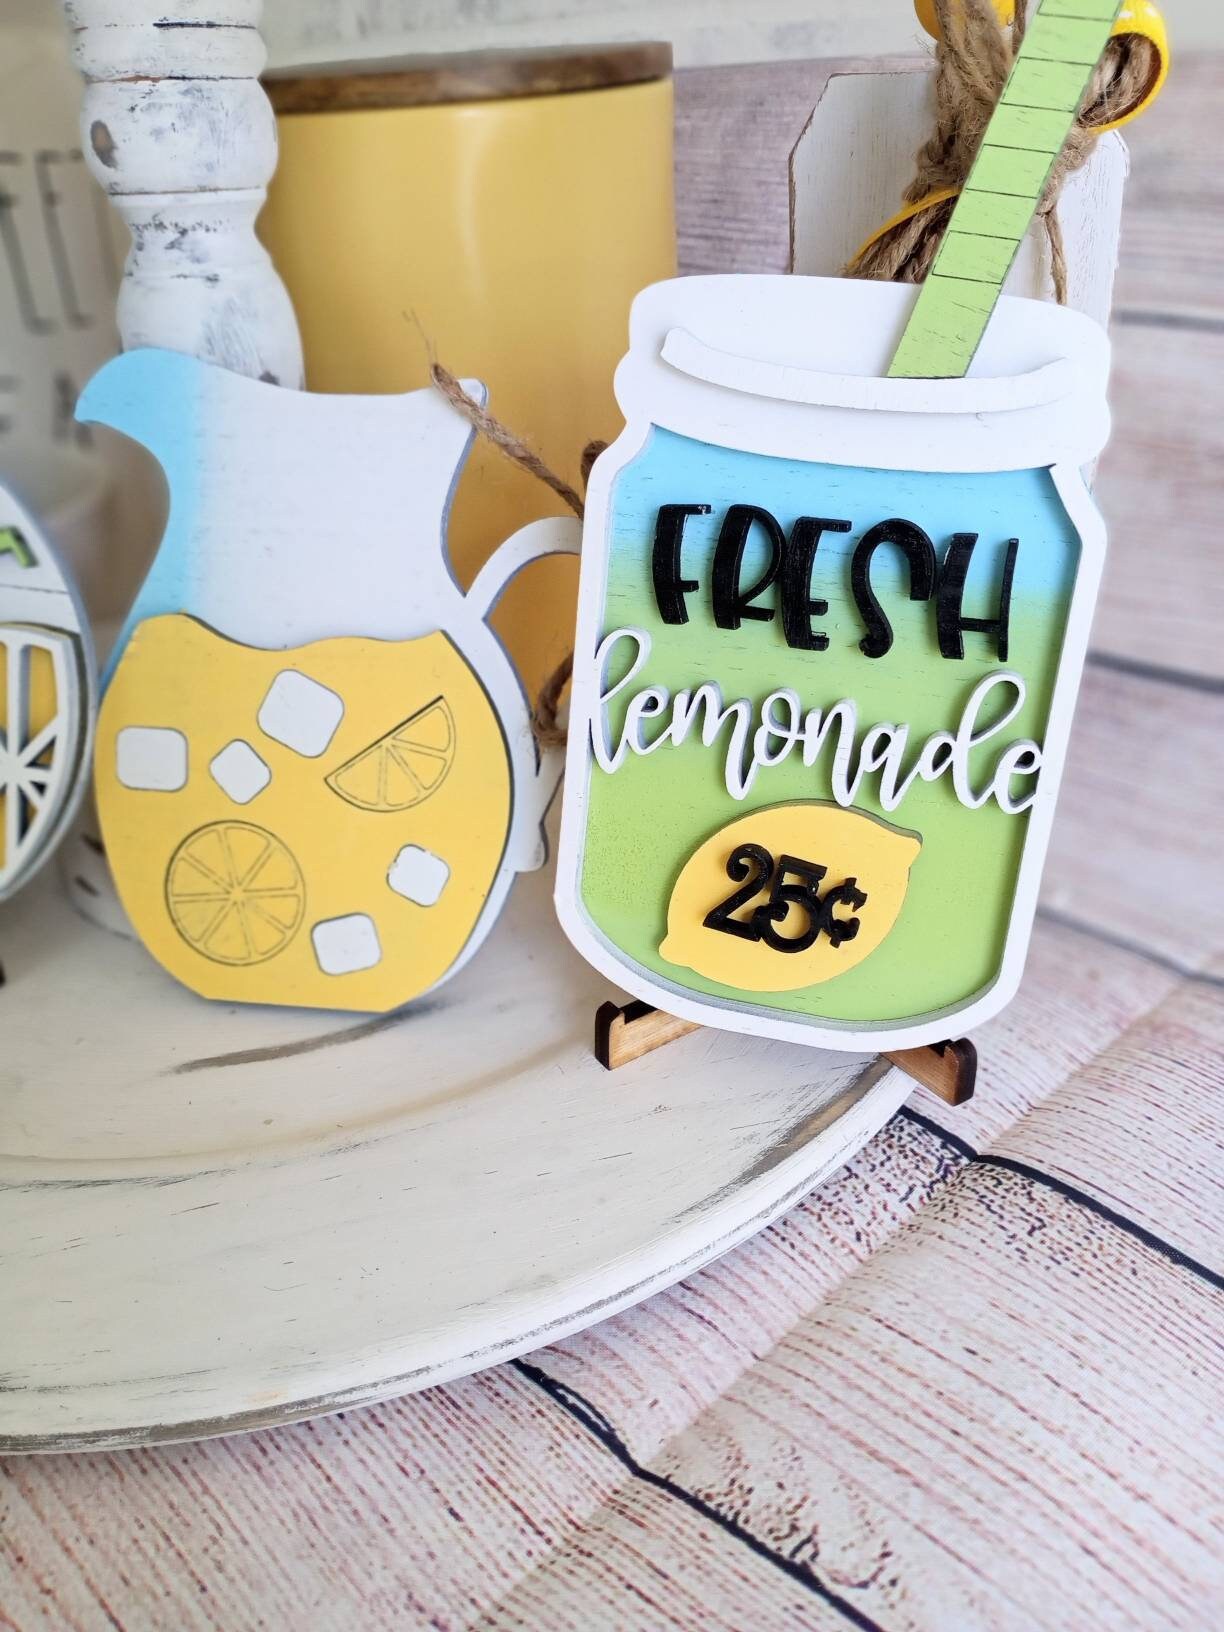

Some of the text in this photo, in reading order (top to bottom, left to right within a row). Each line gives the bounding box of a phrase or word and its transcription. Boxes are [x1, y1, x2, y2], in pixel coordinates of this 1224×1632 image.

[652, 503, 1020, 662] FRESH
[591, 626, 1042, 815] lemonade
[702, 843, 868, 953] 25¢
